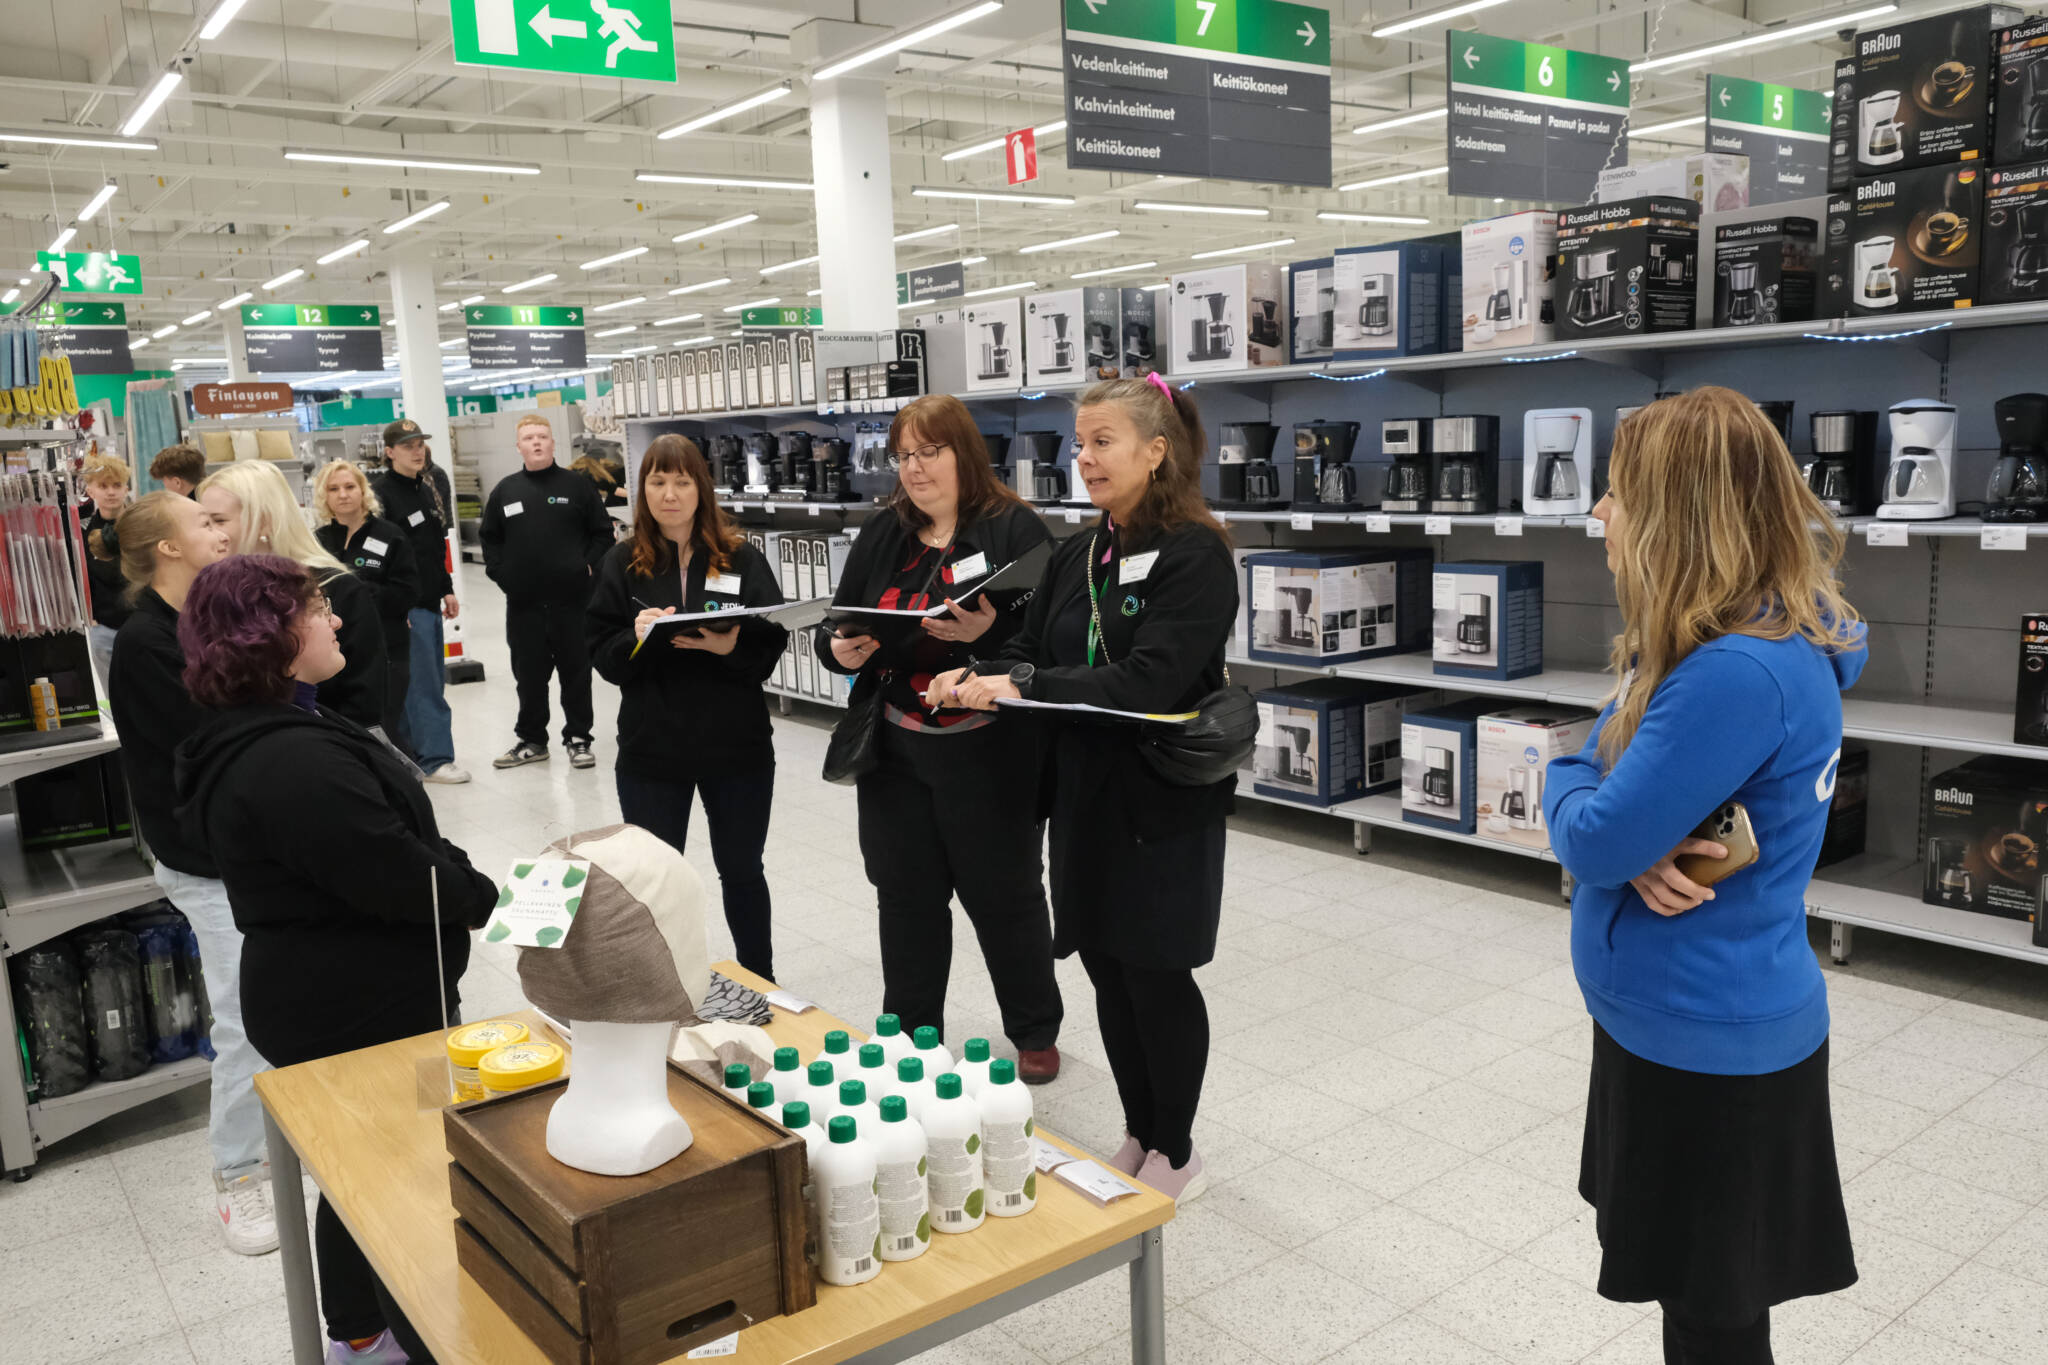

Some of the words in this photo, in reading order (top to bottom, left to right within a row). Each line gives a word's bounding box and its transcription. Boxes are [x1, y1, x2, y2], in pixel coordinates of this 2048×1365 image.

[1196, 1, 1217, 36] 7
[2012, 21, 2048, 41] Russell
[1862, 33, 1901, 56] BRAUN
[1072, 53, 1168, 80] Vedenkeittimet
[1538, 56, 1554, 87] 6
[1837, 64, 1856, 78] BRAU
[1213, 72, 1288, 96] Keittiökoneet
[1074, 96, 1175, 121] Kahvinkeittimet
[1454, 102, 1481, 117] Heirol
[1482, 105, 1542, 125] keittiövälineet
[1772, 94, 1783, 121] 5
[1548, 115, 1576, 130] Pannut
[1577, 118, 1586, 134] ja
[1587, 120, 1610, 135] padat
[1076, 138, 1161, 159] Keittiökoneet
[1455, 136, 1506, 153] Sodastream
[1601, 170, 1637, 182] KENWOOD
[2002, 168, 2038, 182] Russell
[1857, 180, 1896, 200] BRAUN
[1568, 210, 1599, 225] Russell
[1601, 206, 1631, 221] Hobbs
[1726, 227, 1751, 237] Russell
[1753, 224, 1777, 234] Hobbs
[1559, 236, 1590, 247] ATTENTIV
[302, 308, 322, 322] 12
[520, 309, 533, 323] 11
[784, 311, 797, 323] 10
[208, 388, 279, 402] Finlayson
[1934, 788, 1973, 806] BRAUN
